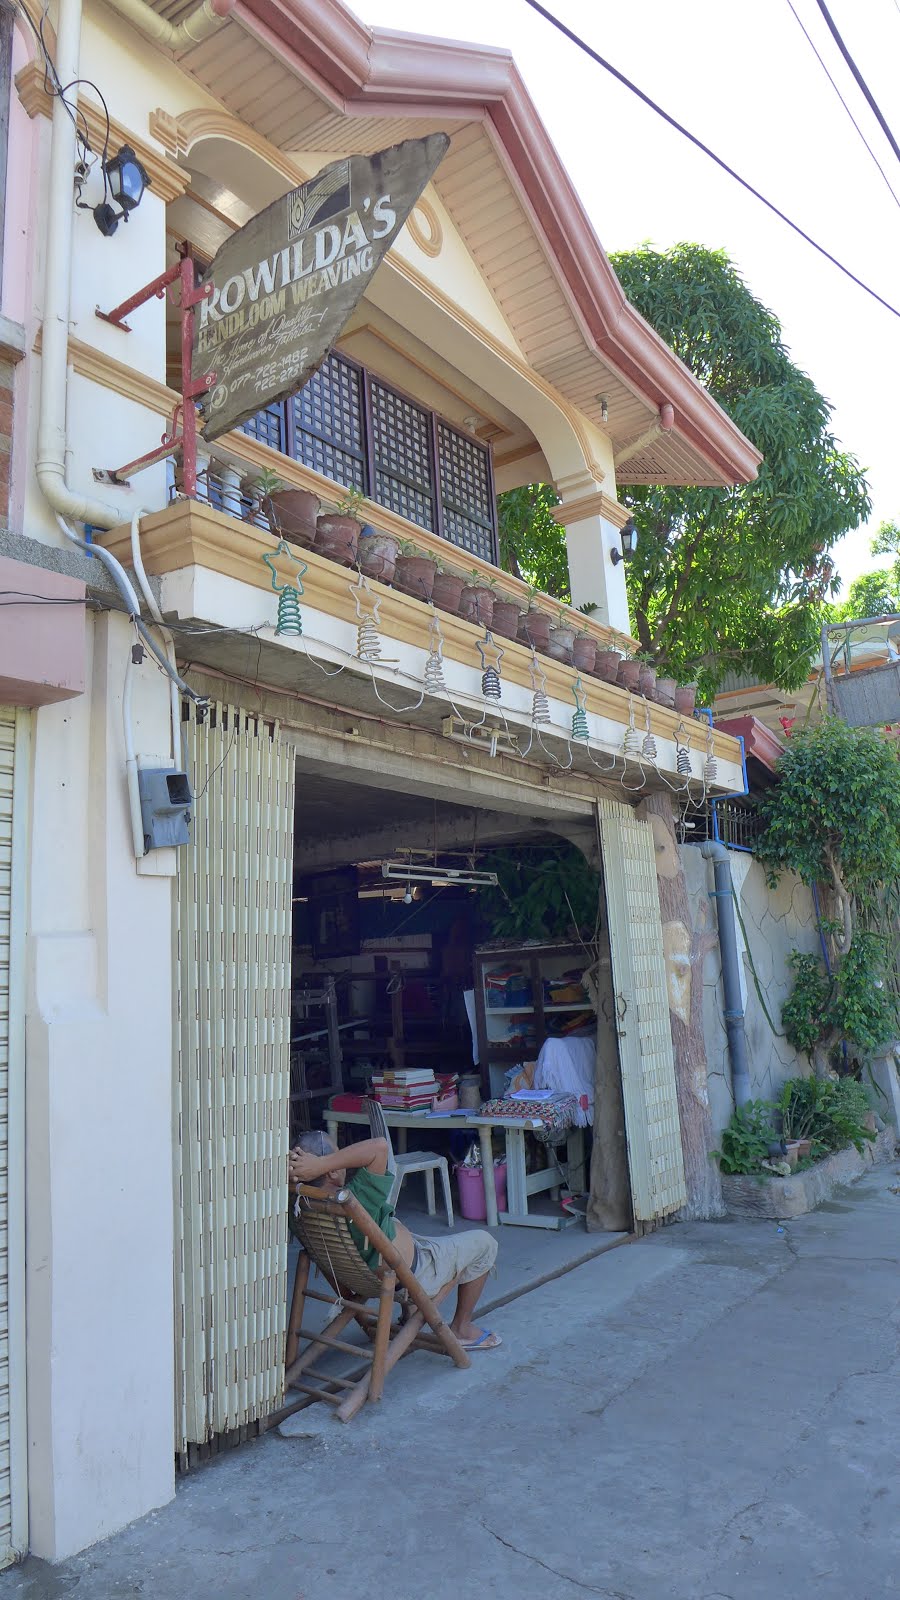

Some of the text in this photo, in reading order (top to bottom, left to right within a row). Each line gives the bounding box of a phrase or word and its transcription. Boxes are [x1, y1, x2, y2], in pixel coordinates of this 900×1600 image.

[196, 246, 374, 353] HANDLOOM WEAVING
[199, 194, 397, 330] ROWILDA'S
[203, 303, 323, 375] The Home of Quality
[253, 361, 305, 393] 722-2731
